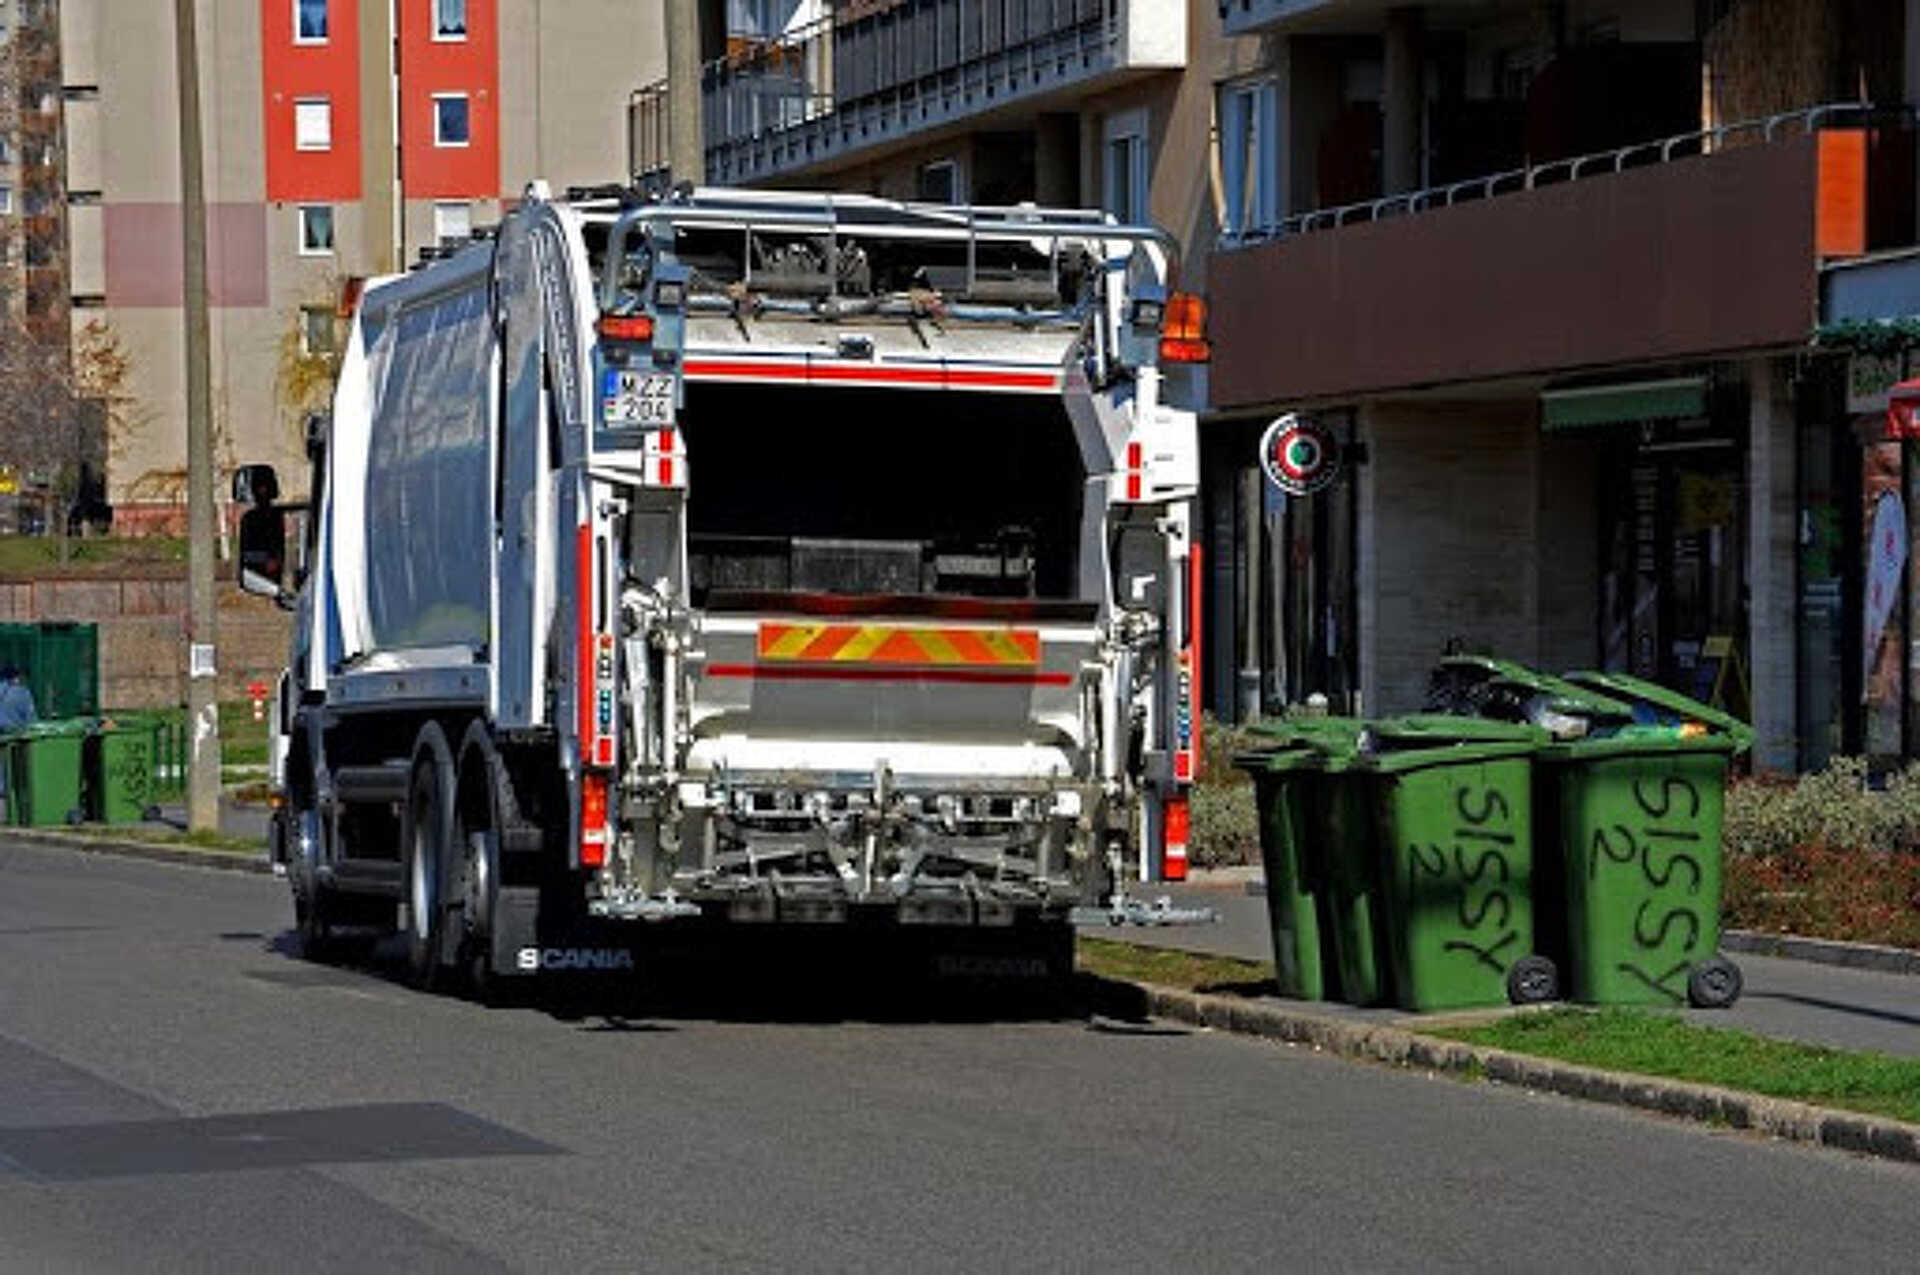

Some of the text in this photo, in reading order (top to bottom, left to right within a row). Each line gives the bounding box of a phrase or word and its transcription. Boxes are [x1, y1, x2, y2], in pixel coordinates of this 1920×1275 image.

[1408, 843, 1449, 892] 2
[1443, 786, 1518, 974] SISSY
[1590, 823, 1637, 882] 2
[1615, 776, 1702, 1004] SISSY
[517, 948, 632, 969] SCANIA
